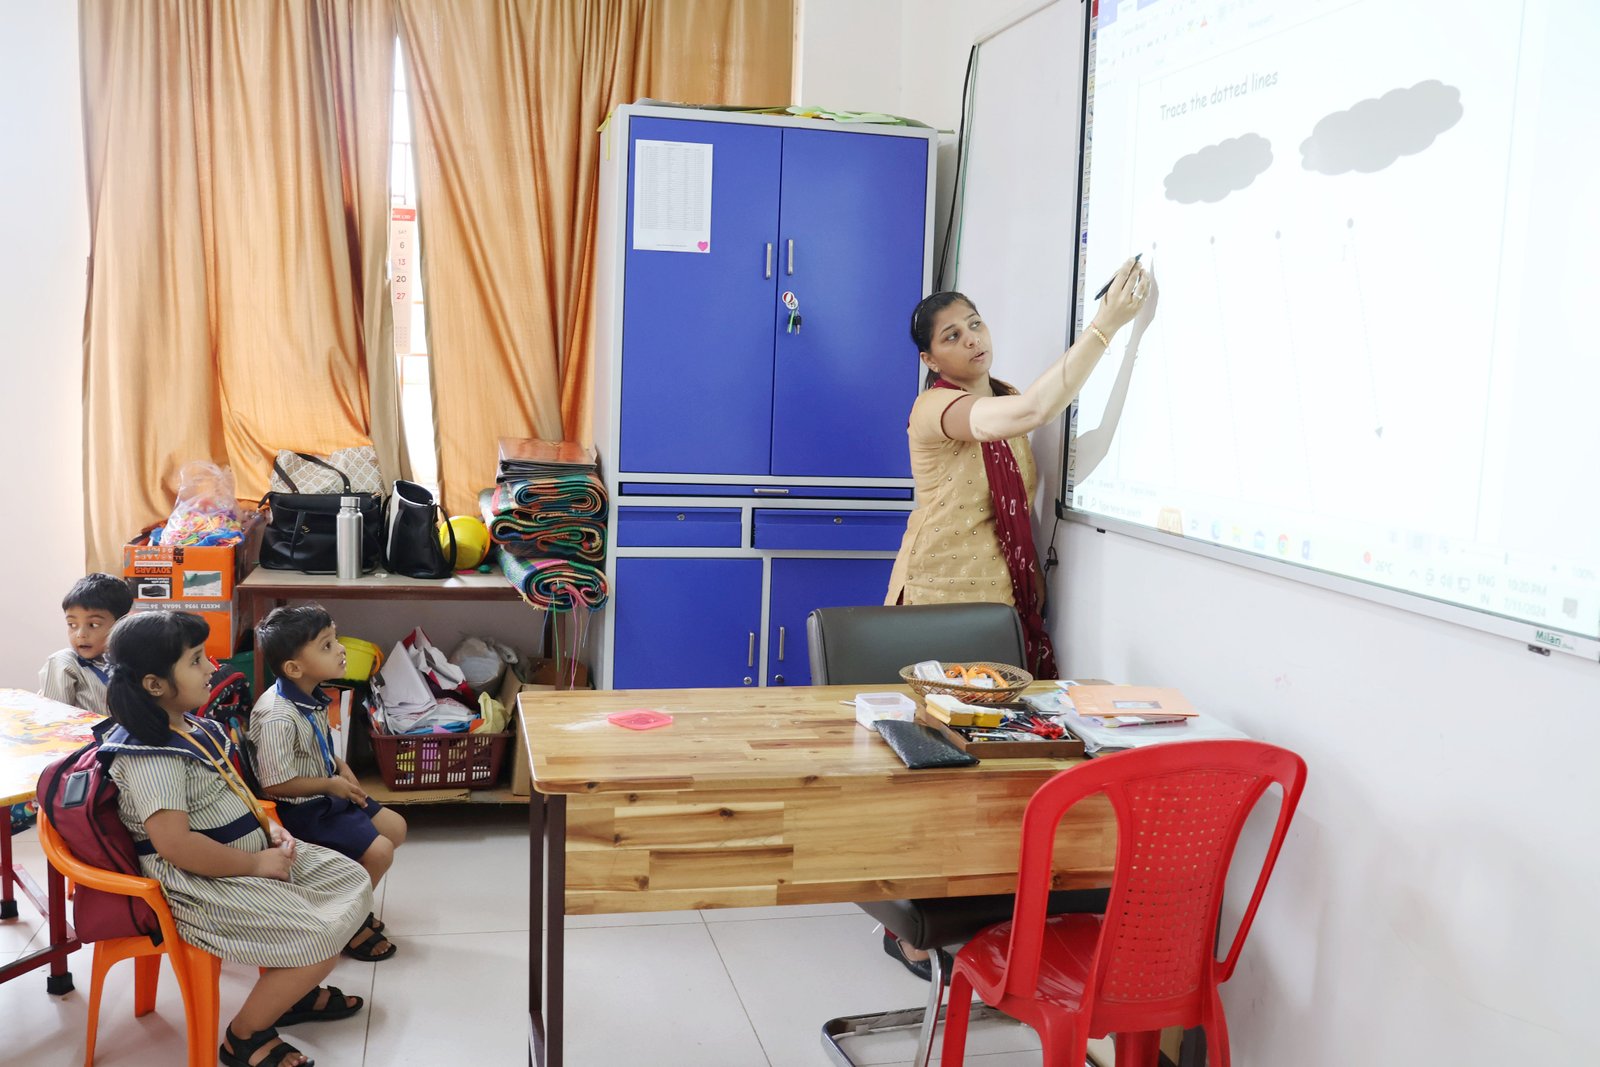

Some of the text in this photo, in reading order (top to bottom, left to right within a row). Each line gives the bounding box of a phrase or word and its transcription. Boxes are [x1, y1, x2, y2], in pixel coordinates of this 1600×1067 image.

[1160, 71, 1279, 121] Trace the dotted lines
[397, 258, 406, 266] 13
[396, 275, 407, 283] 20
[396, 292, 406, 300] 27
[1477, 573, 1496, 588] ENG
[1531, 583, 1548, 597] PM
[1535, 630, 1561, 646] Milan
